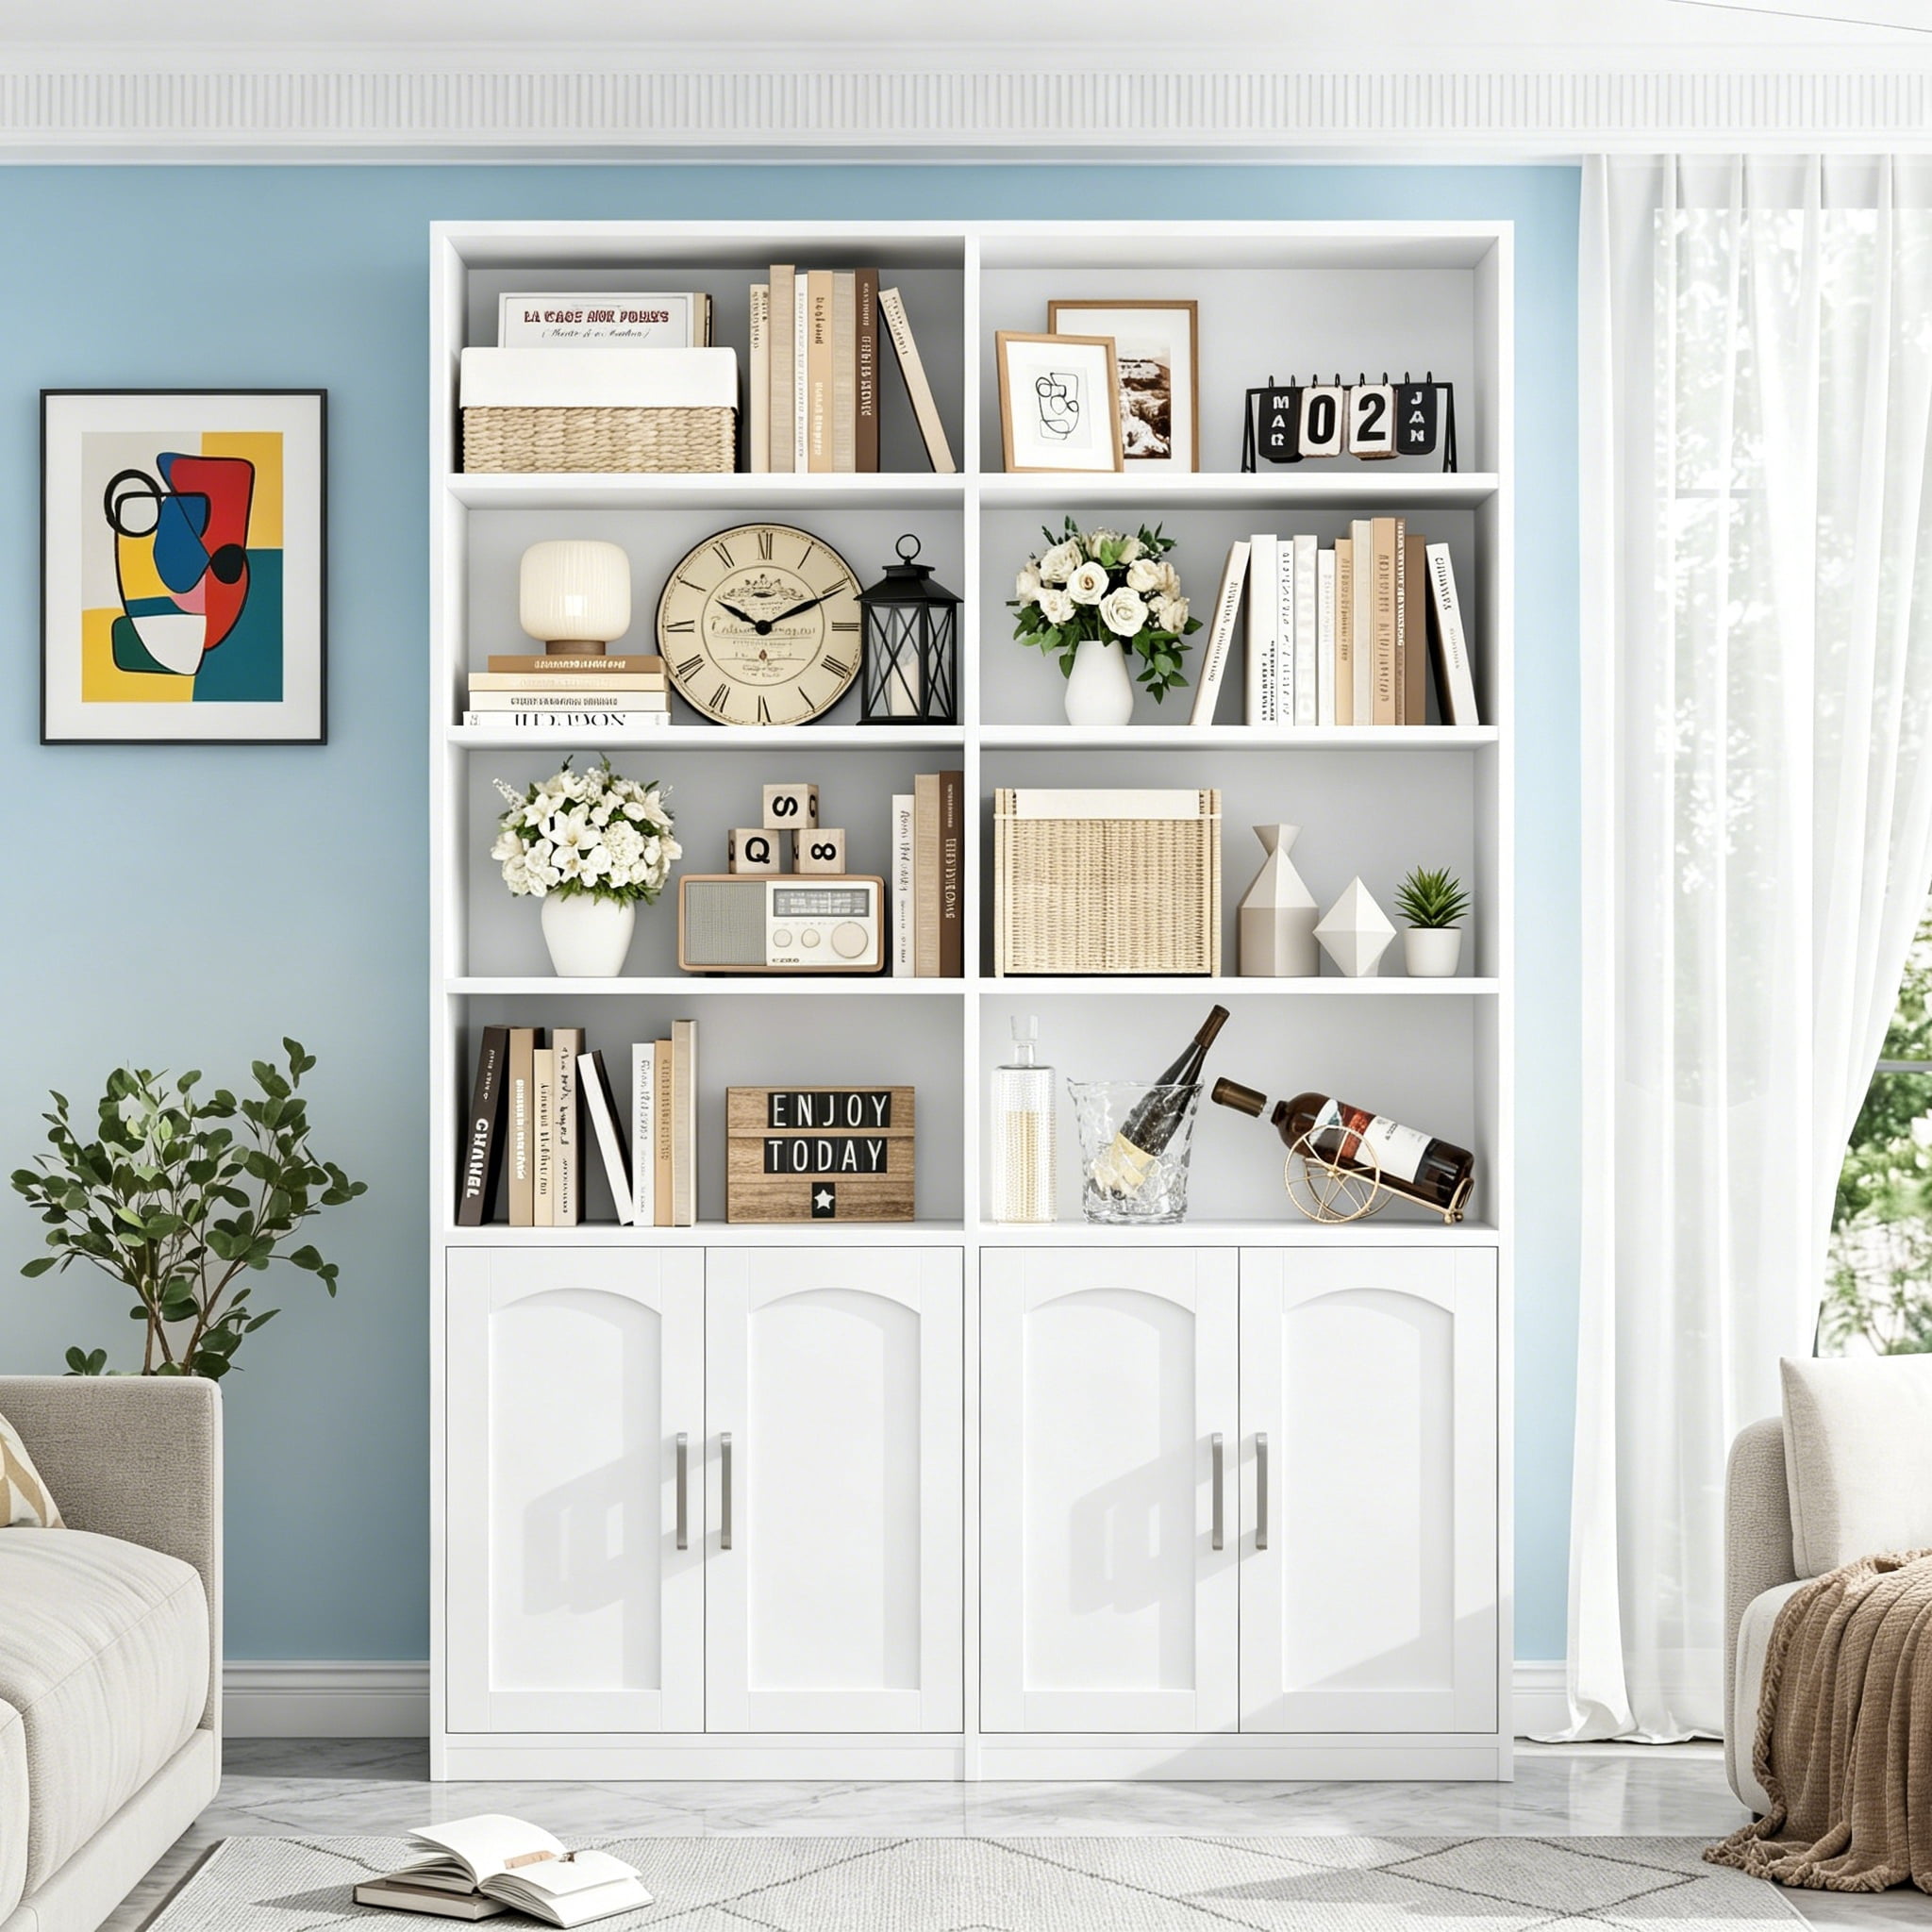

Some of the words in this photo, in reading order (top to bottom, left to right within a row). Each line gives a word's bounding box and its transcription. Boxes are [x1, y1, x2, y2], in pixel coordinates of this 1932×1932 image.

[745, 837, 771, 864] Q
[810, 842, 837, 861] 8
[773, 1094, 888, 1127] ENJOY
[768, 1140, 883, 1172] TODAY
